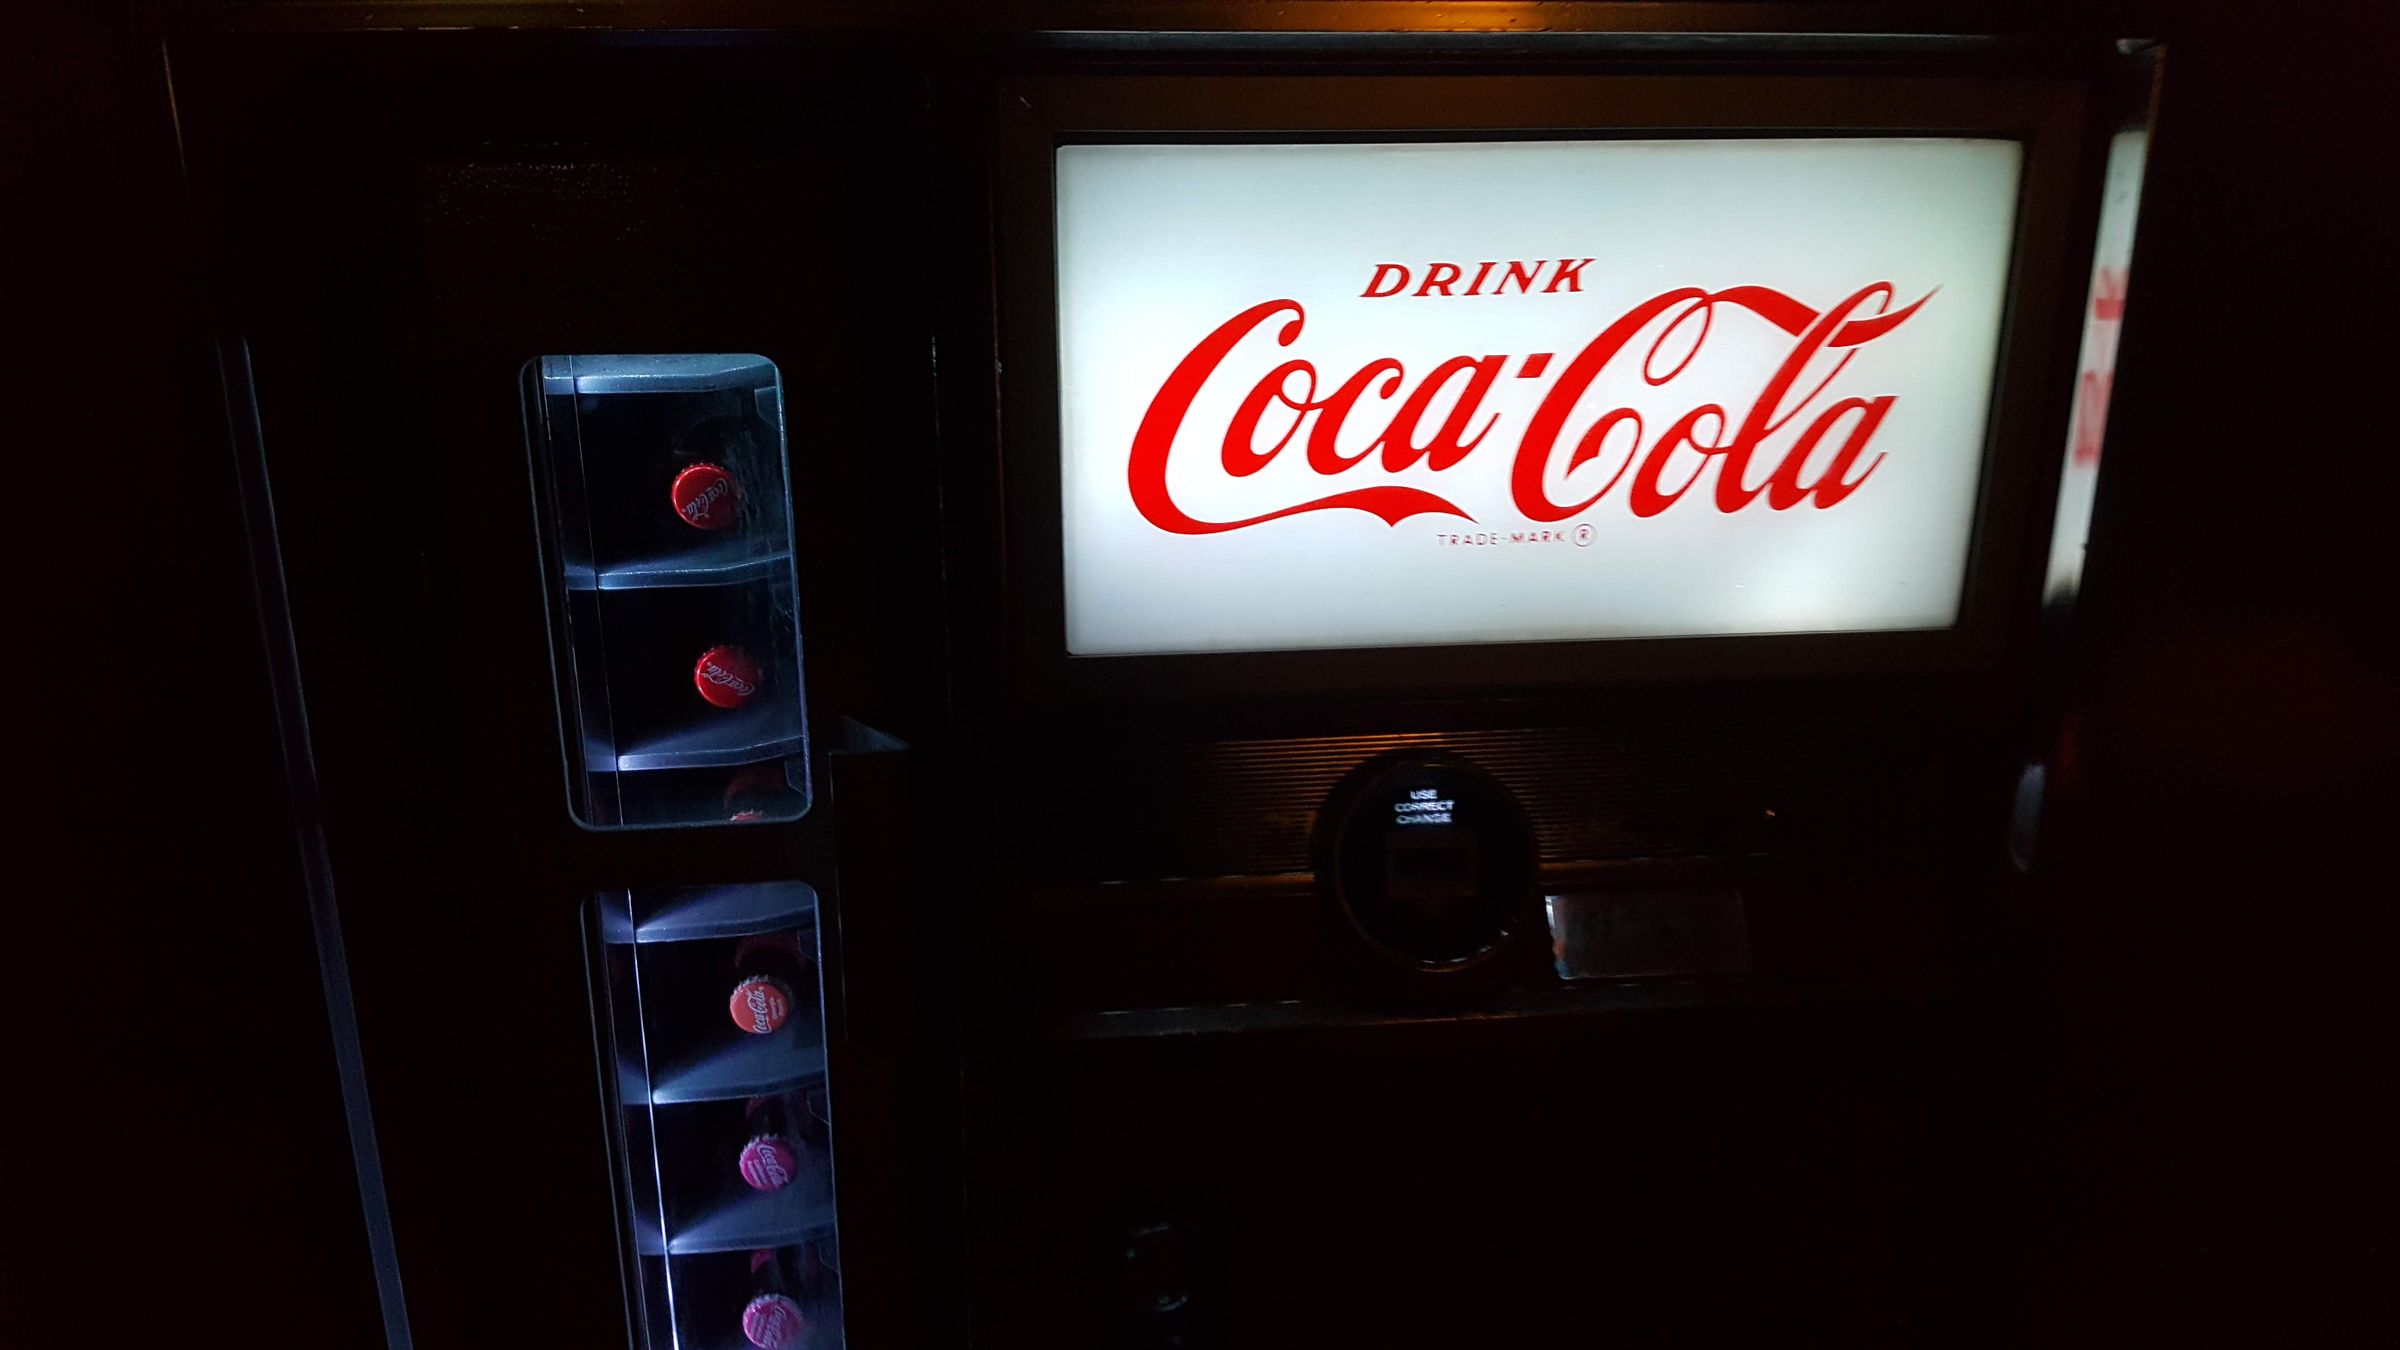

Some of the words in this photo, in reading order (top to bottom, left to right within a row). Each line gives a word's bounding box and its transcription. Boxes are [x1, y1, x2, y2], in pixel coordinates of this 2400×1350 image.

[1361, 257, 1596, 299] DRINK
[1126, 281, 1943, 536] Coca-Cola
[1437, 530, 1566, 546] TRADE-MARK
[1409, 788, 1438, 800] USE
[1394, 800, 1455, 812] CORRECT
